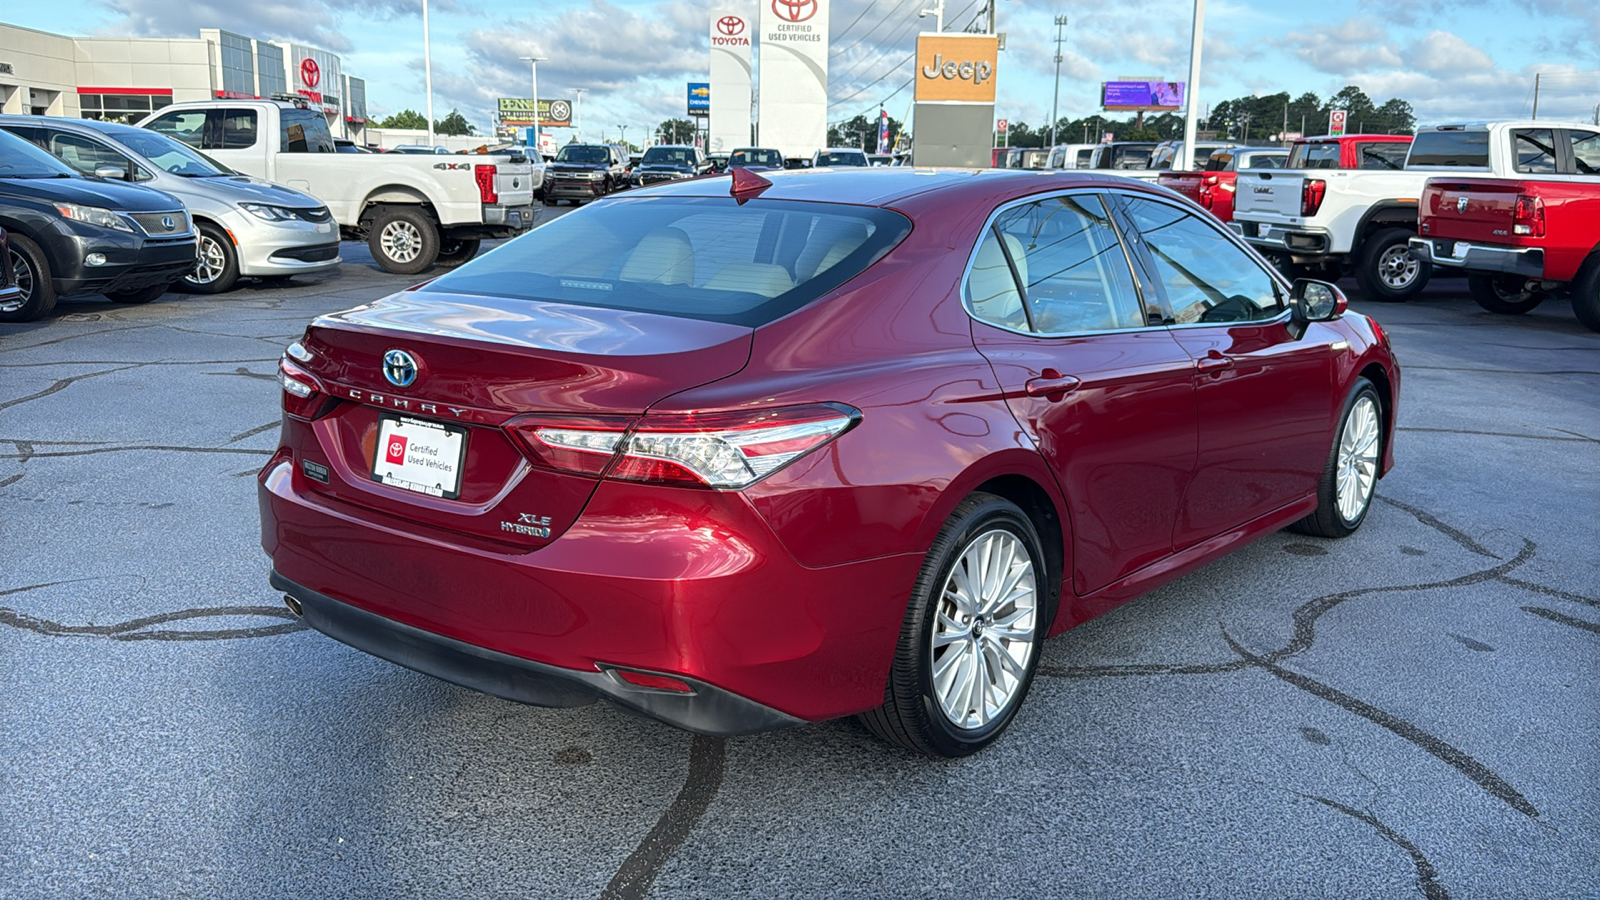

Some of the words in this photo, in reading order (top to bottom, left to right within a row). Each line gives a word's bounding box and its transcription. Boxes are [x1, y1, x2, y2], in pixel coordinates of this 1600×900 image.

[778, 24, 812, 32] CERTIFIED
[711, 37, 749, 46] TOYOTA
[768, 33, 787, 41] USED
[788, 33, 821, 42] VEHICLES
[922, 53, 992, 85] Jeep
[349, 389, 467, 417] CAMRY
[409, 443, 439, 456] Certified
[407, 455, 424, 466] Used
[425, 458, 452, 472] Vehicles
[517, 512, 552, 526] XLE
[500, 521, 544, 537] HYBRID
